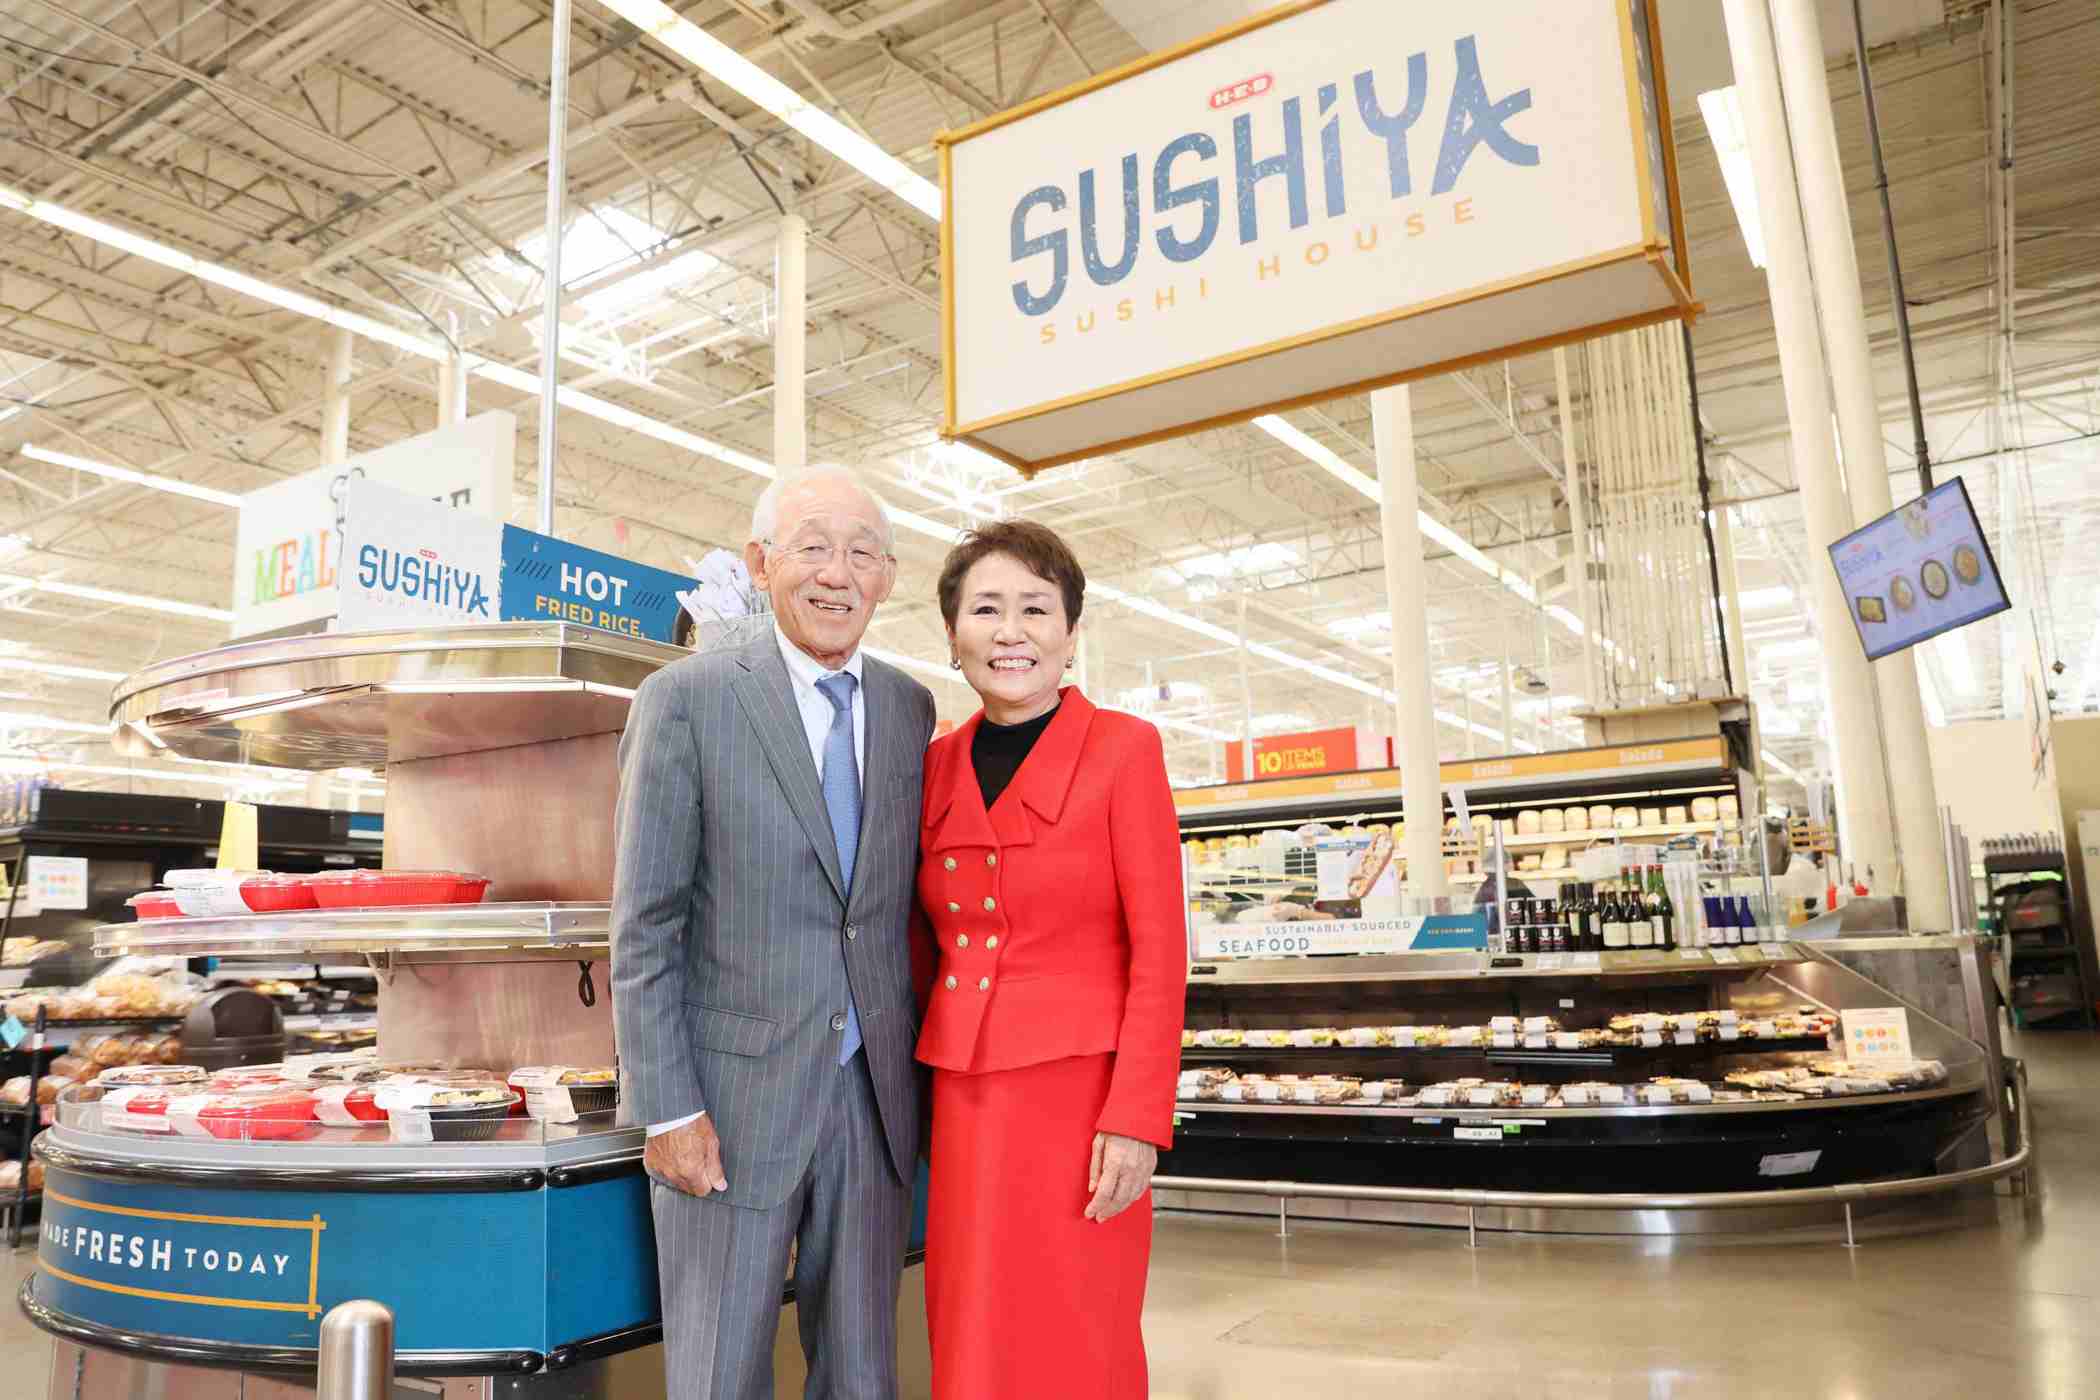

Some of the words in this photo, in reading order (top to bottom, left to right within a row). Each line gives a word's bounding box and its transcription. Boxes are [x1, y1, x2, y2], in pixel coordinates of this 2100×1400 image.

[1040, 279, 1206, 345] SUSHI
[1258, 198, 1474, 280] HOUSE
[254, 528, 336, 604] MEAL
[560, 562, 628, 607] HOT
[535, 594, 594, 626] FRIED
[1256, 751, 1282, 774] 10
[1219, 937, 1311, 953] SEAFOOD
[1265, 920, 1346, 935] SUSTAINABLY
[1352, 920, 1411, 933] SOURCED
[74, 1226, 173, 1271] FRESH
[184, 1247, 290, 1275] TODAY
